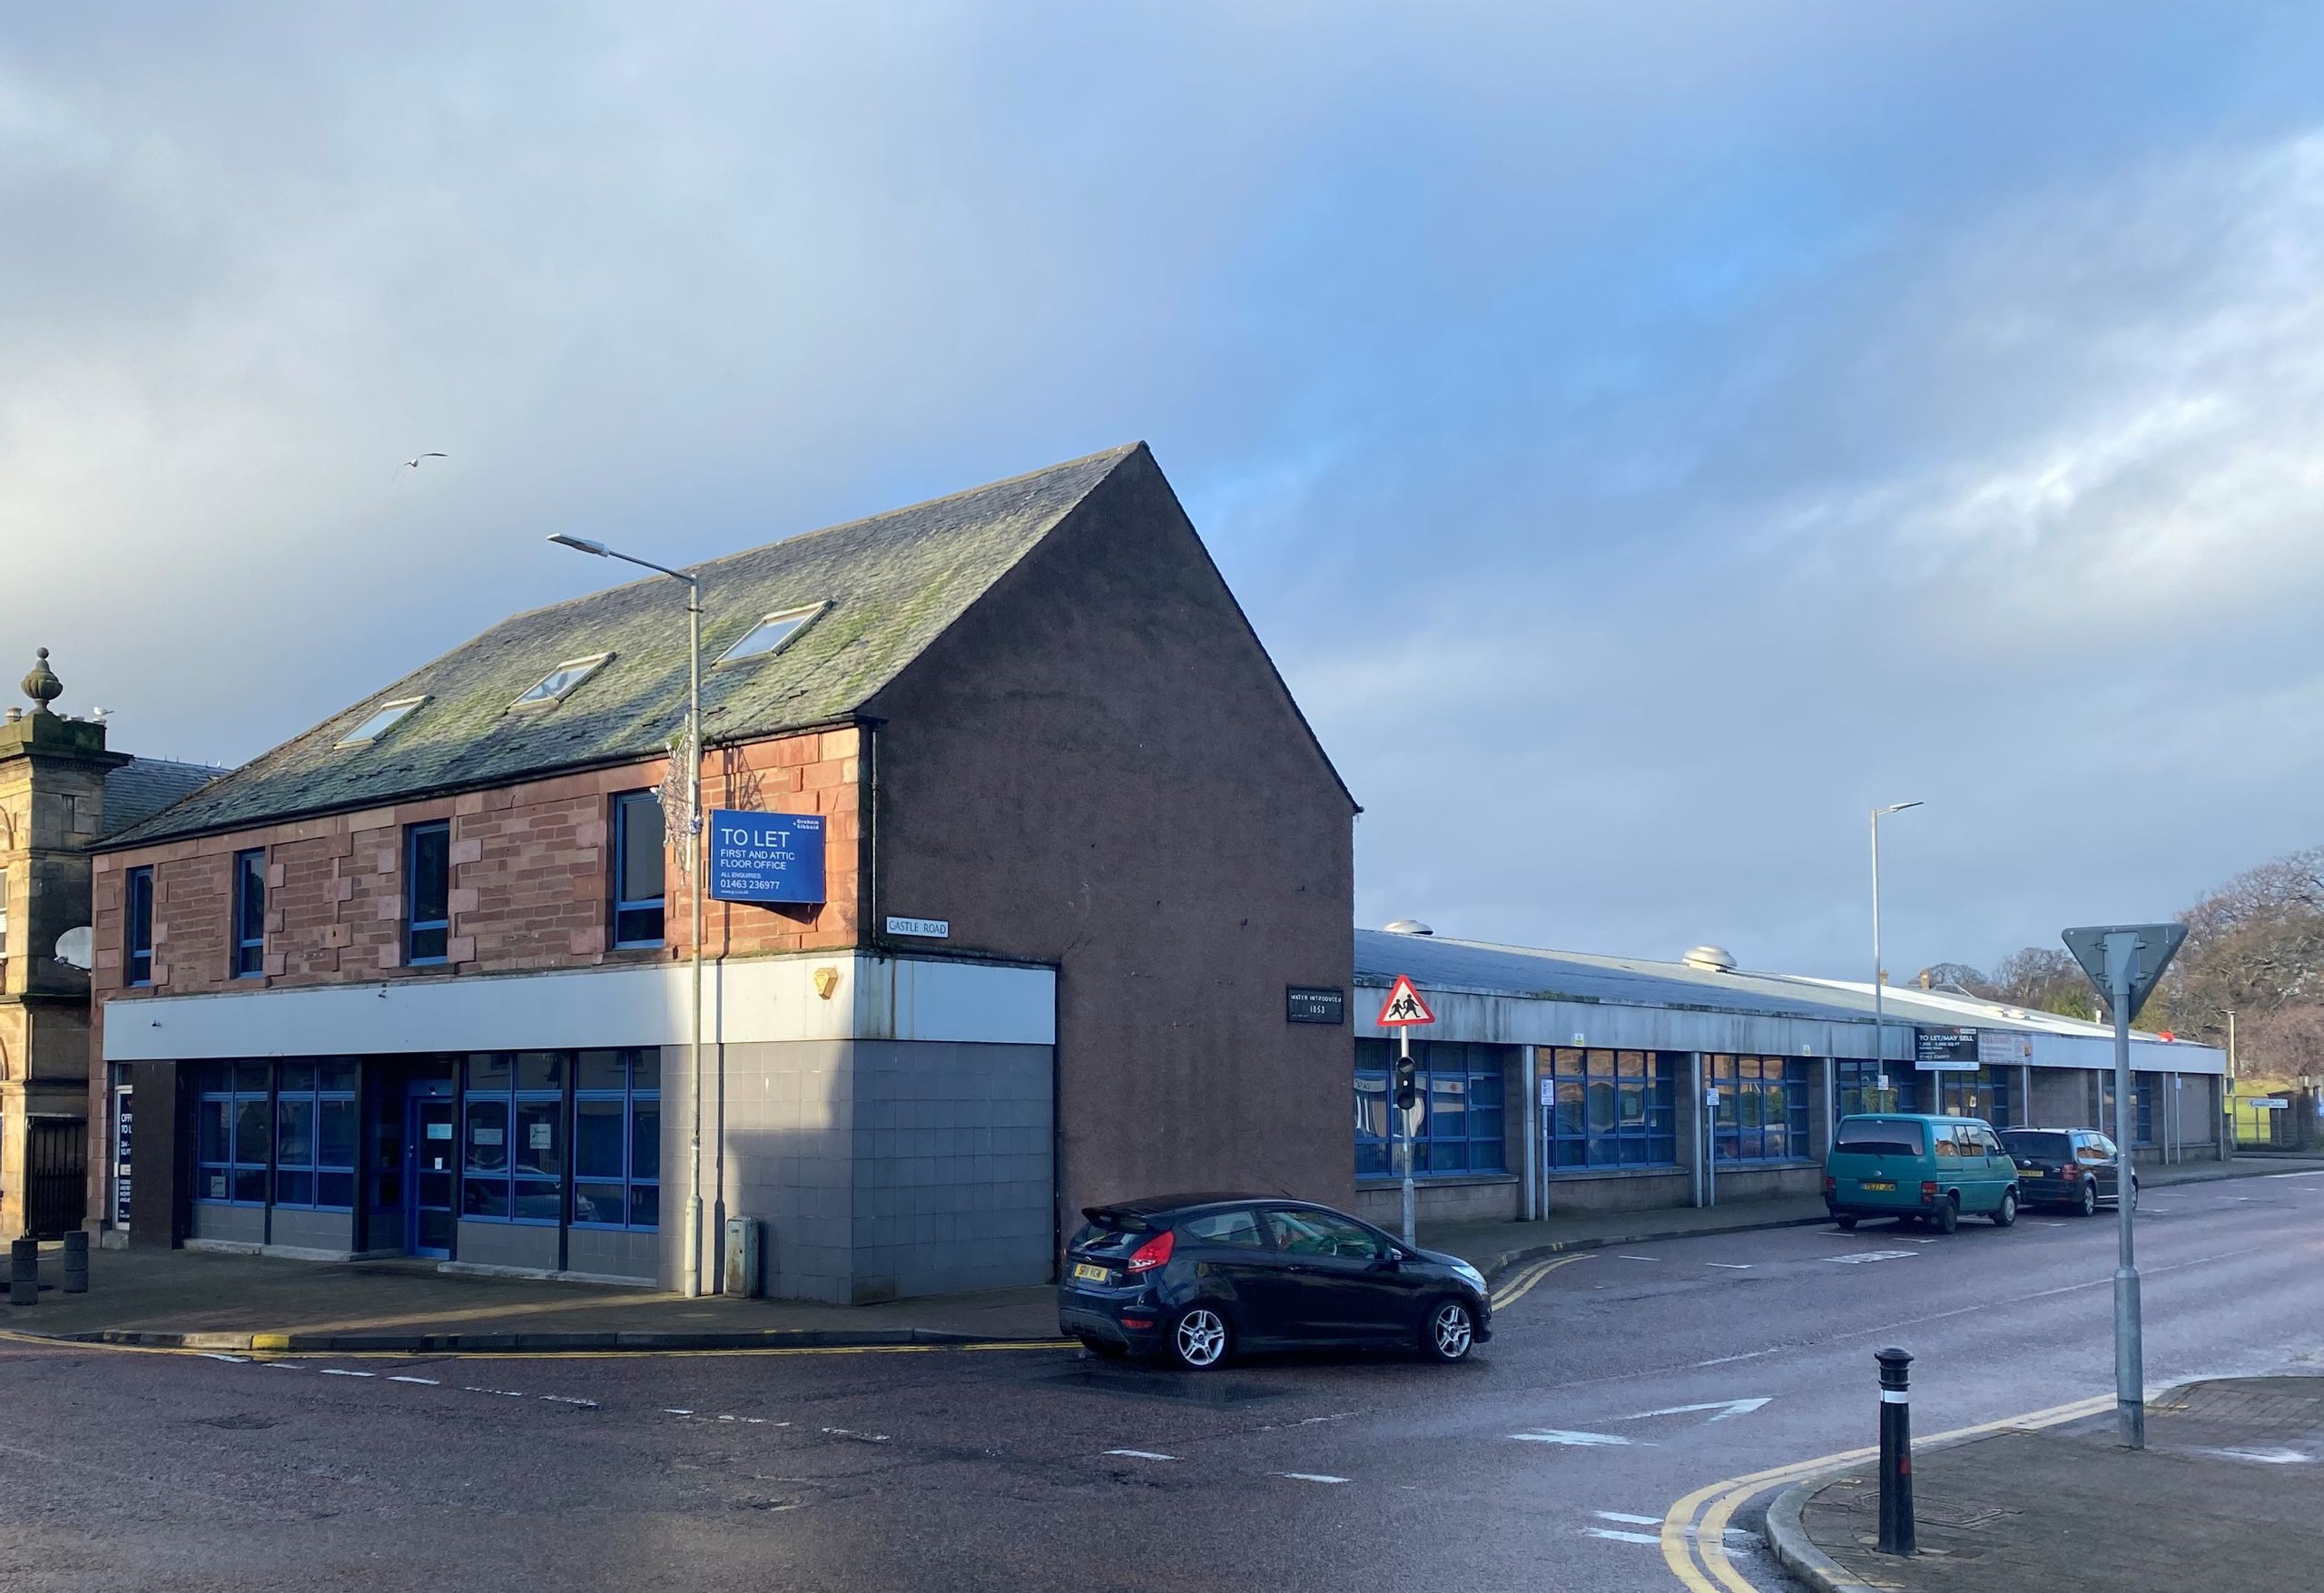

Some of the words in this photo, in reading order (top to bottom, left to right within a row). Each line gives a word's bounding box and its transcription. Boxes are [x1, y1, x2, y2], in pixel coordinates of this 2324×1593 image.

[721, 829, 748, 846] TO
[754, 830, 790, 848] LET
[720, 849, 746, 858] FIRST
[749, 851, 768, 859] AND
[770, 851, 795, 860] ATTIC
[720, 860, 752, 869] FLOOR
[753, 860, 787, 870] OFFICE
[720, 879, 747, 889] 01463
[749, 880, 780, 890] 236977
[890, 920, 919, 932] CASTLE
[923, 923, 947, 934] ROAD
[121, 1125, 128, 1134] TO
